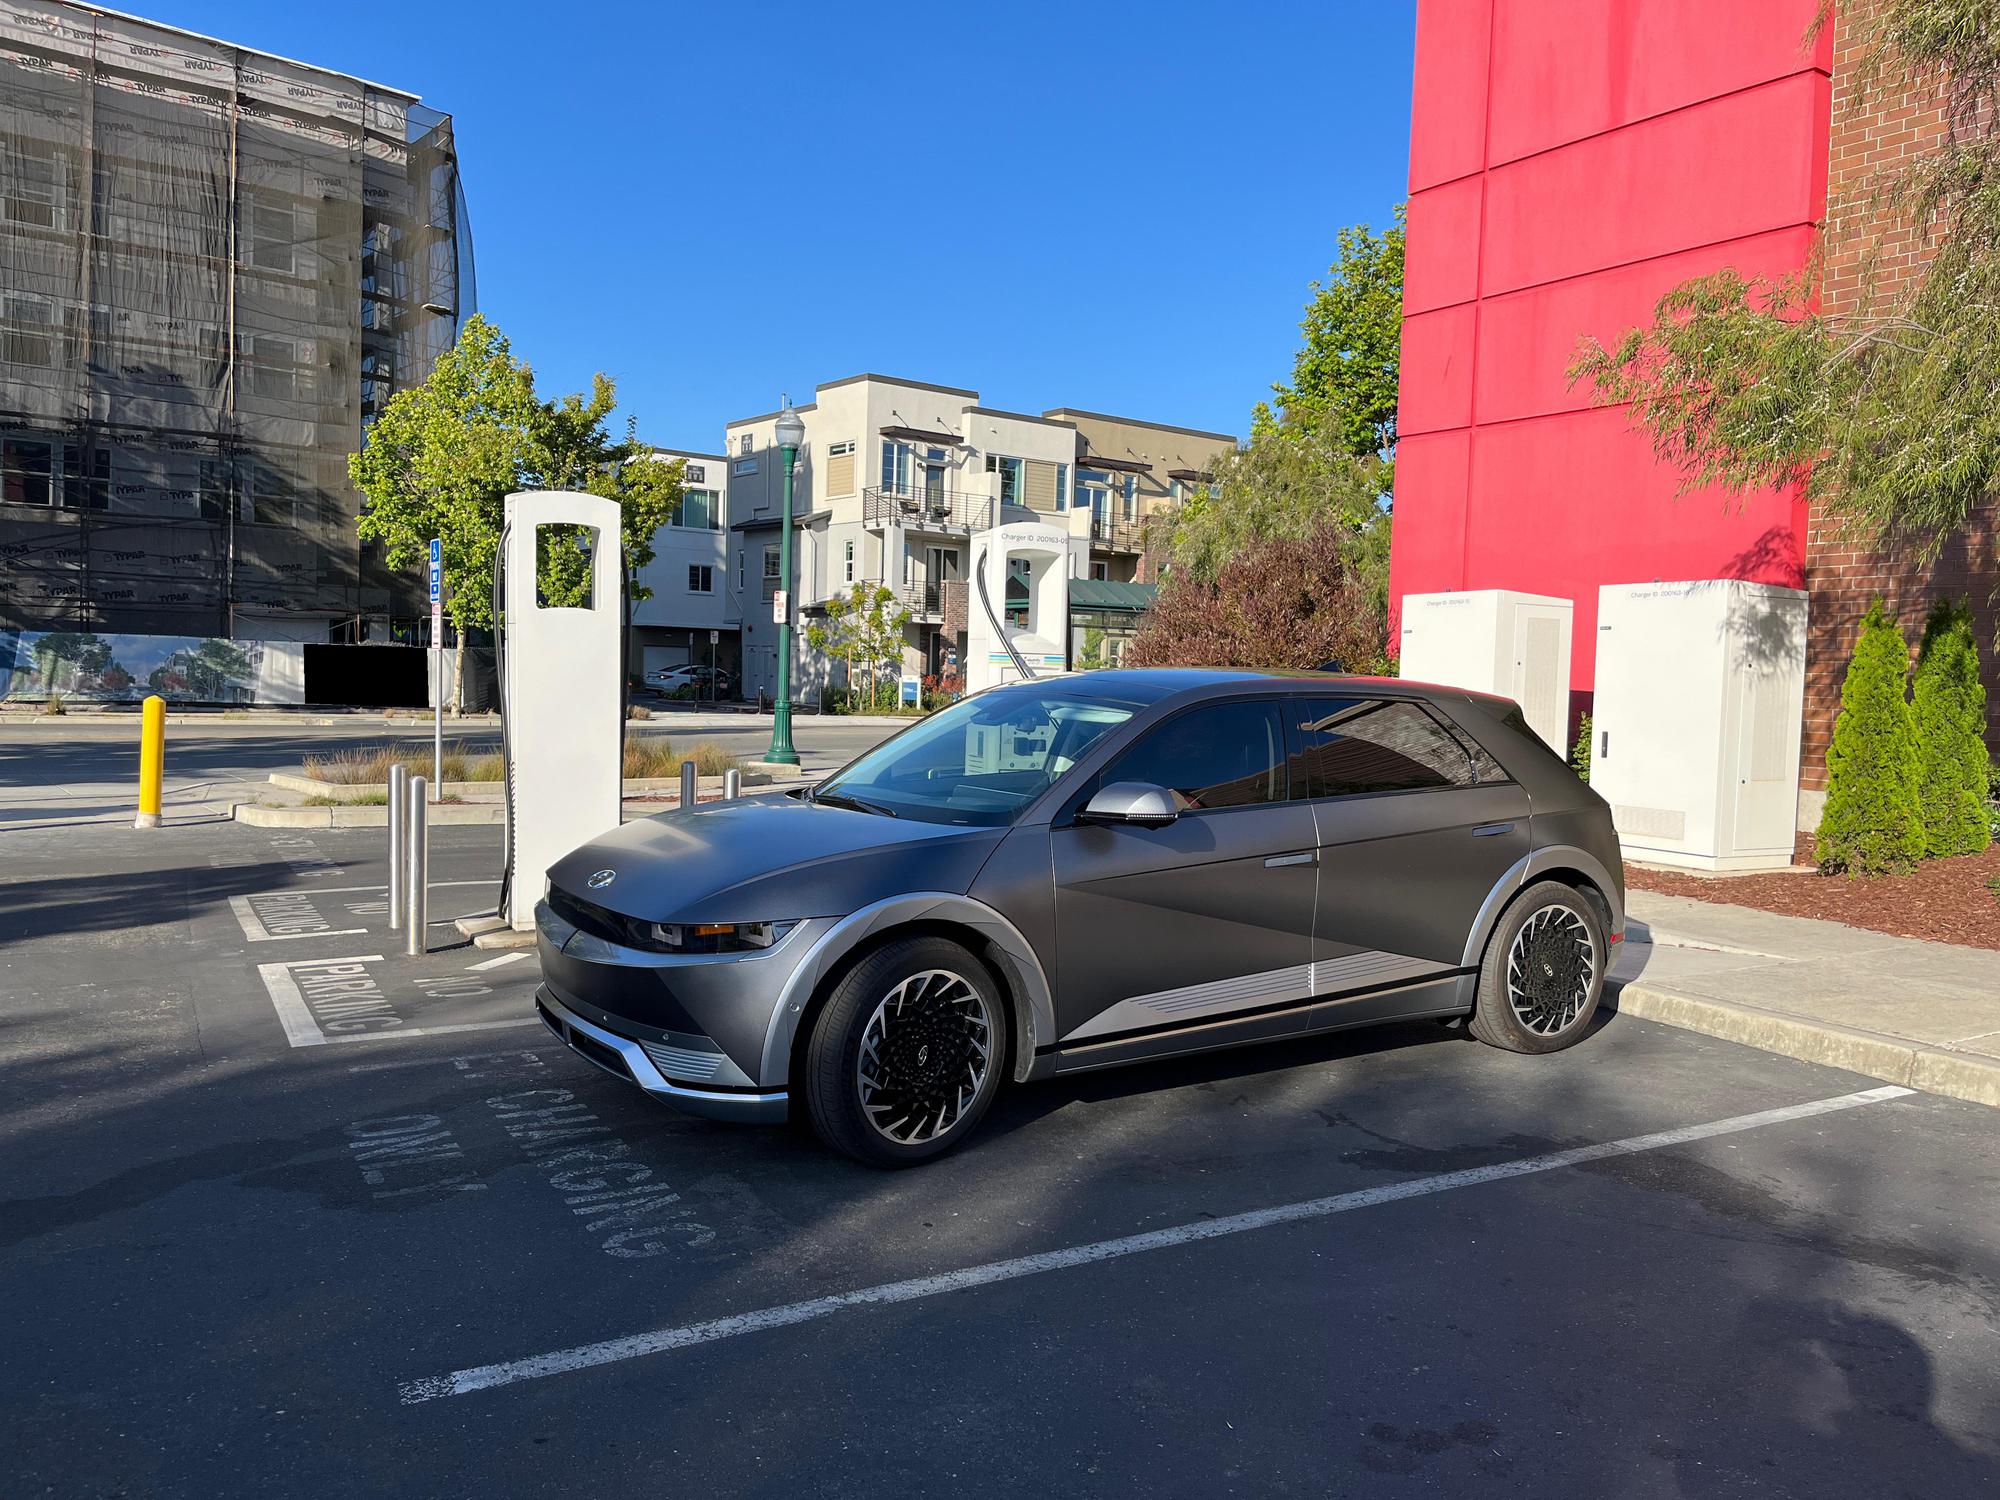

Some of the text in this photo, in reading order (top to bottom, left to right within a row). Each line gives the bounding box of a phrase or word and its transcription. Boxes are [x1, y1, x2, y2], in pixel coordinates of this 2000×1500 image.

[130, 45, 161, 57] TYPAR
[185, 60, 215, 71] TYPAR
[134, 82, 166, 93] TYPAR
[288, 87, 315, 97] TYPAR
[189, 95, 219, 105] TYPAR
[111, 434, 144, 443] TYPAR
[169, 441, 199, 450] TYPAR
[1001, 532, 1026, 542] Charger
[113, 551, 146, 560] TYPAR
[170, 553, 200, 564] TYPAR
[102, 590, 135, 600] TYPAR
[158, 593, 190, 603] TYPAR
[252, 893, 331, 934] PARKING
[413, 975, 494, 998] NO
[294, 963, 404, 1033] PARKING
[486, 1088, 717, 1259] CHARGING
